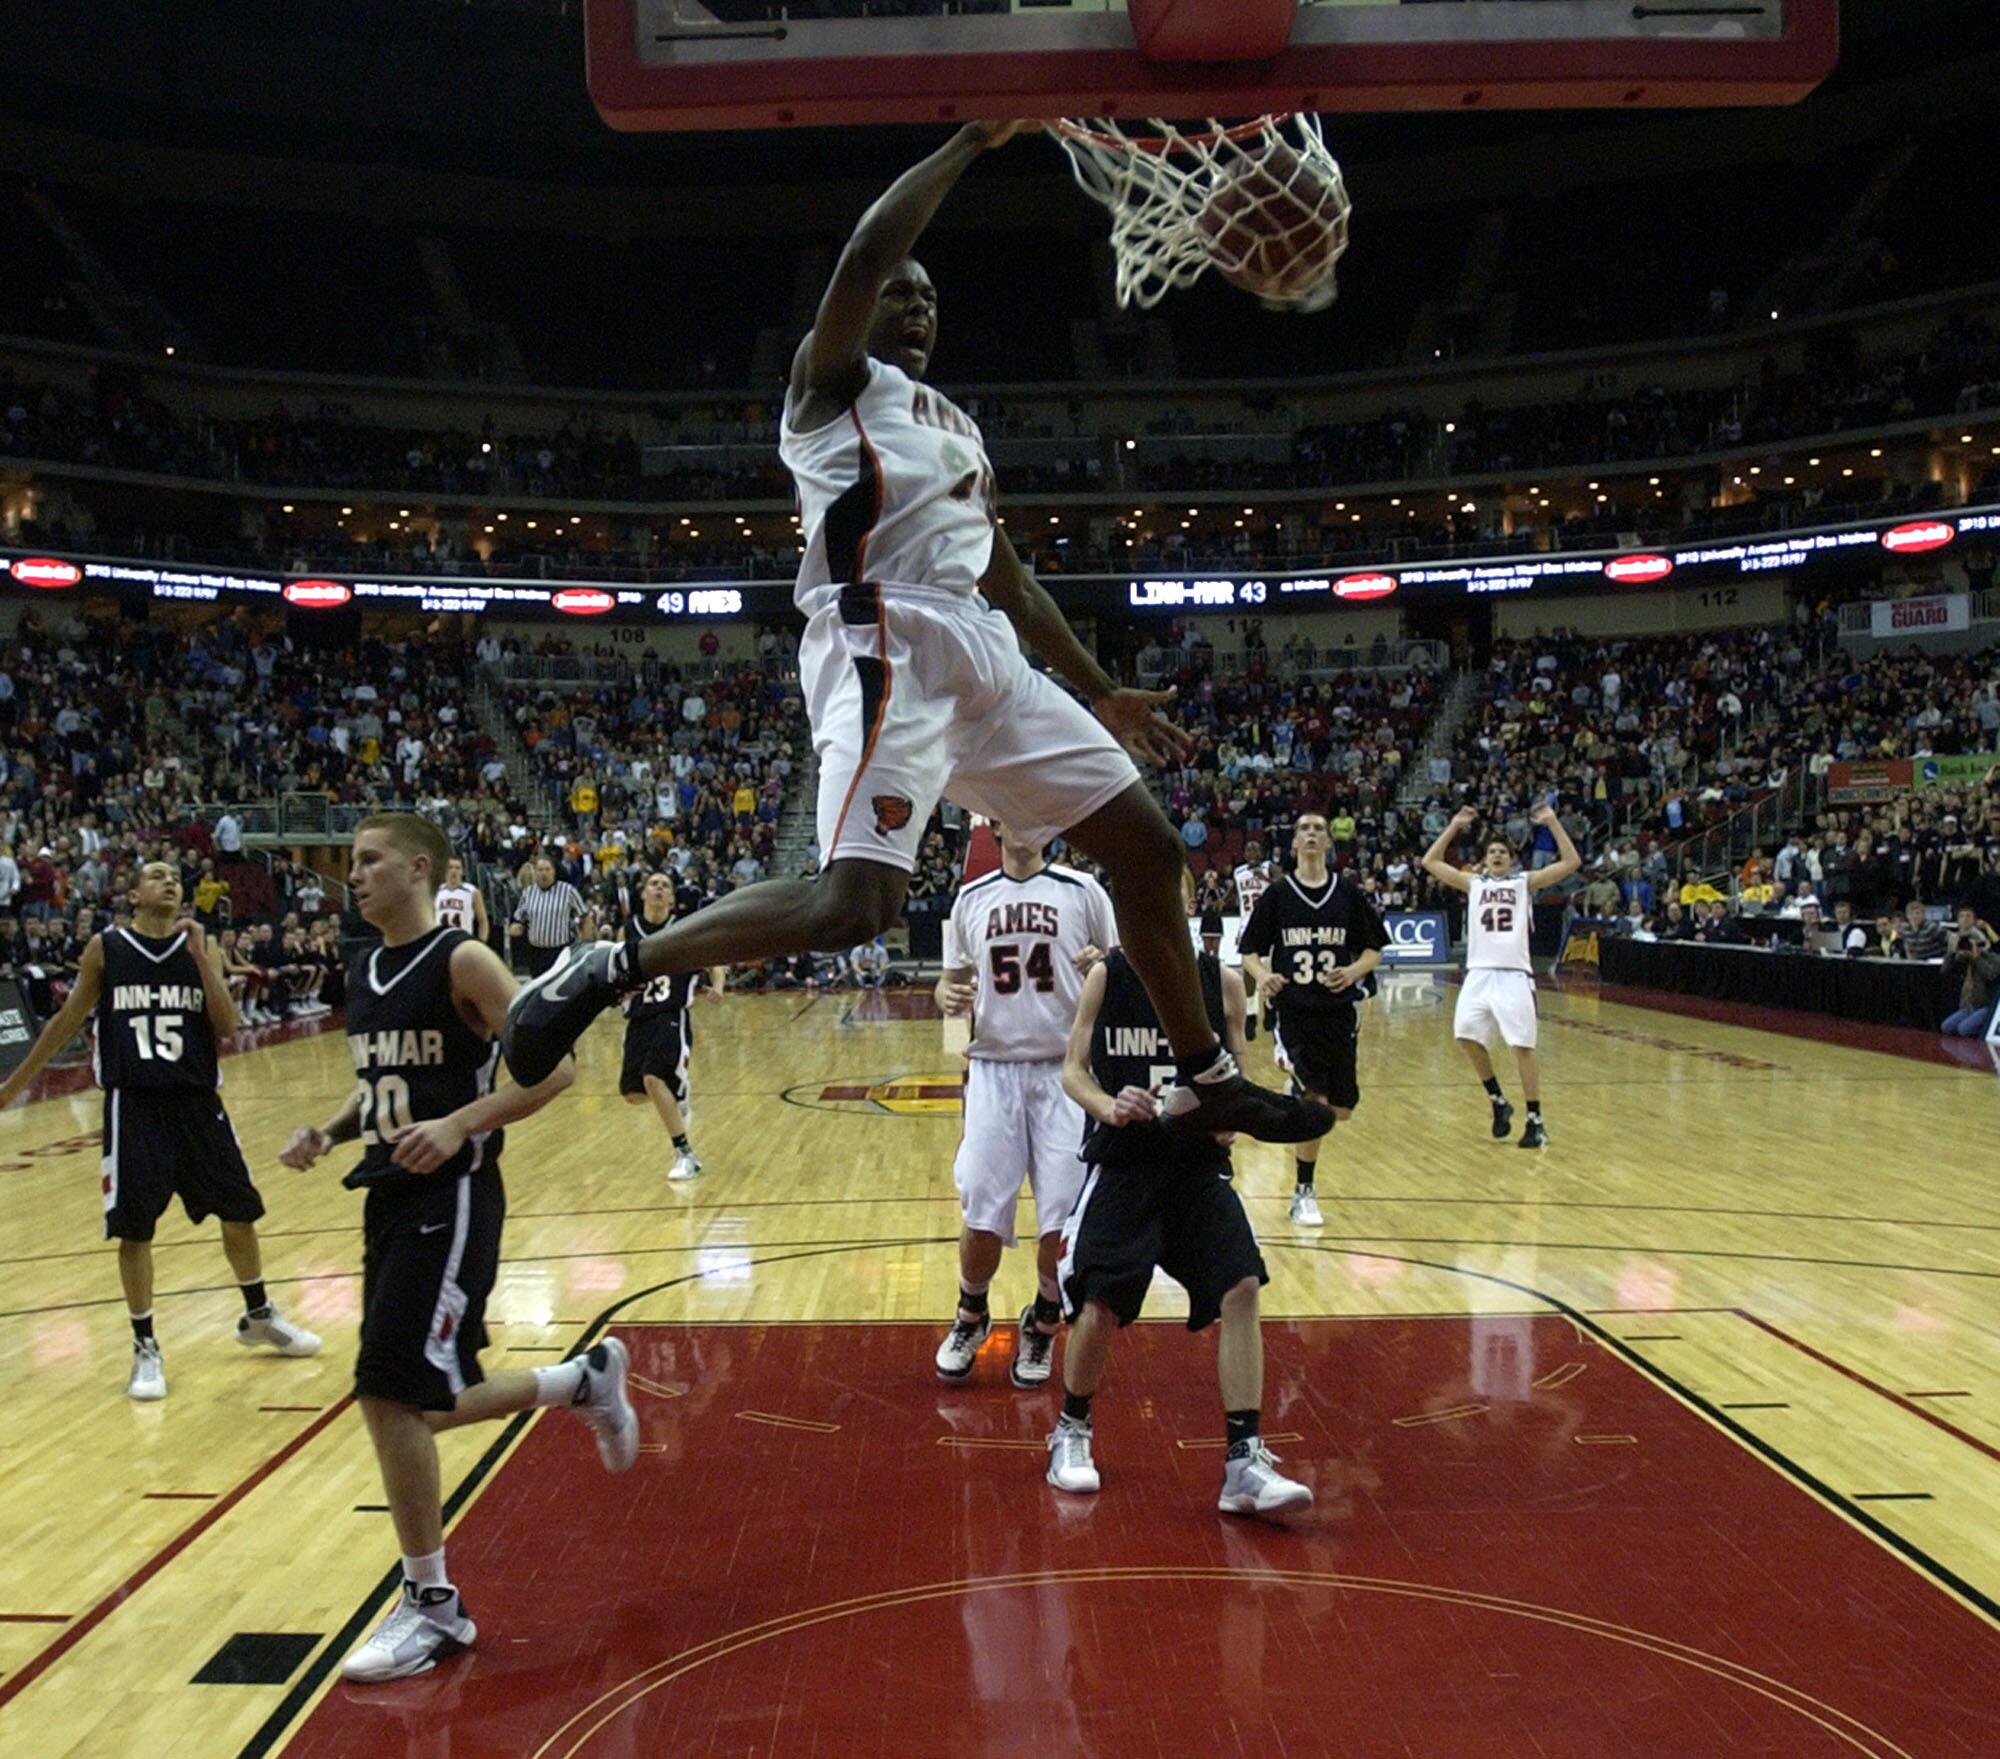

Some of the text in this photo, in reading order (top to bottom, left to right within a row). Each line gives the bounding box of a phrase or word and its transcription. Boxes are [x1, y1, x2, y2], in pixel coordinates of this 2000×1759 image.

[657, 592, 684, 614] 49
[1240, 581, 1266, 604] 43
[1700, 588, 1739, 607] 112
[1891, 607, 1948, 628] GUARD
[610, 628, 646, 644] 108
[1479, 888, 1517, 906] AMES
[986, 901, 1059, 941] AMES
[1480, 908, 1514, 933] 42
[989, 941, 1055, 996] 54
[1292, 950, 1337, 986] 33
[128, 1014, 184, 1063] 15
[1105, 1026, 1175, 1057] LINN-
